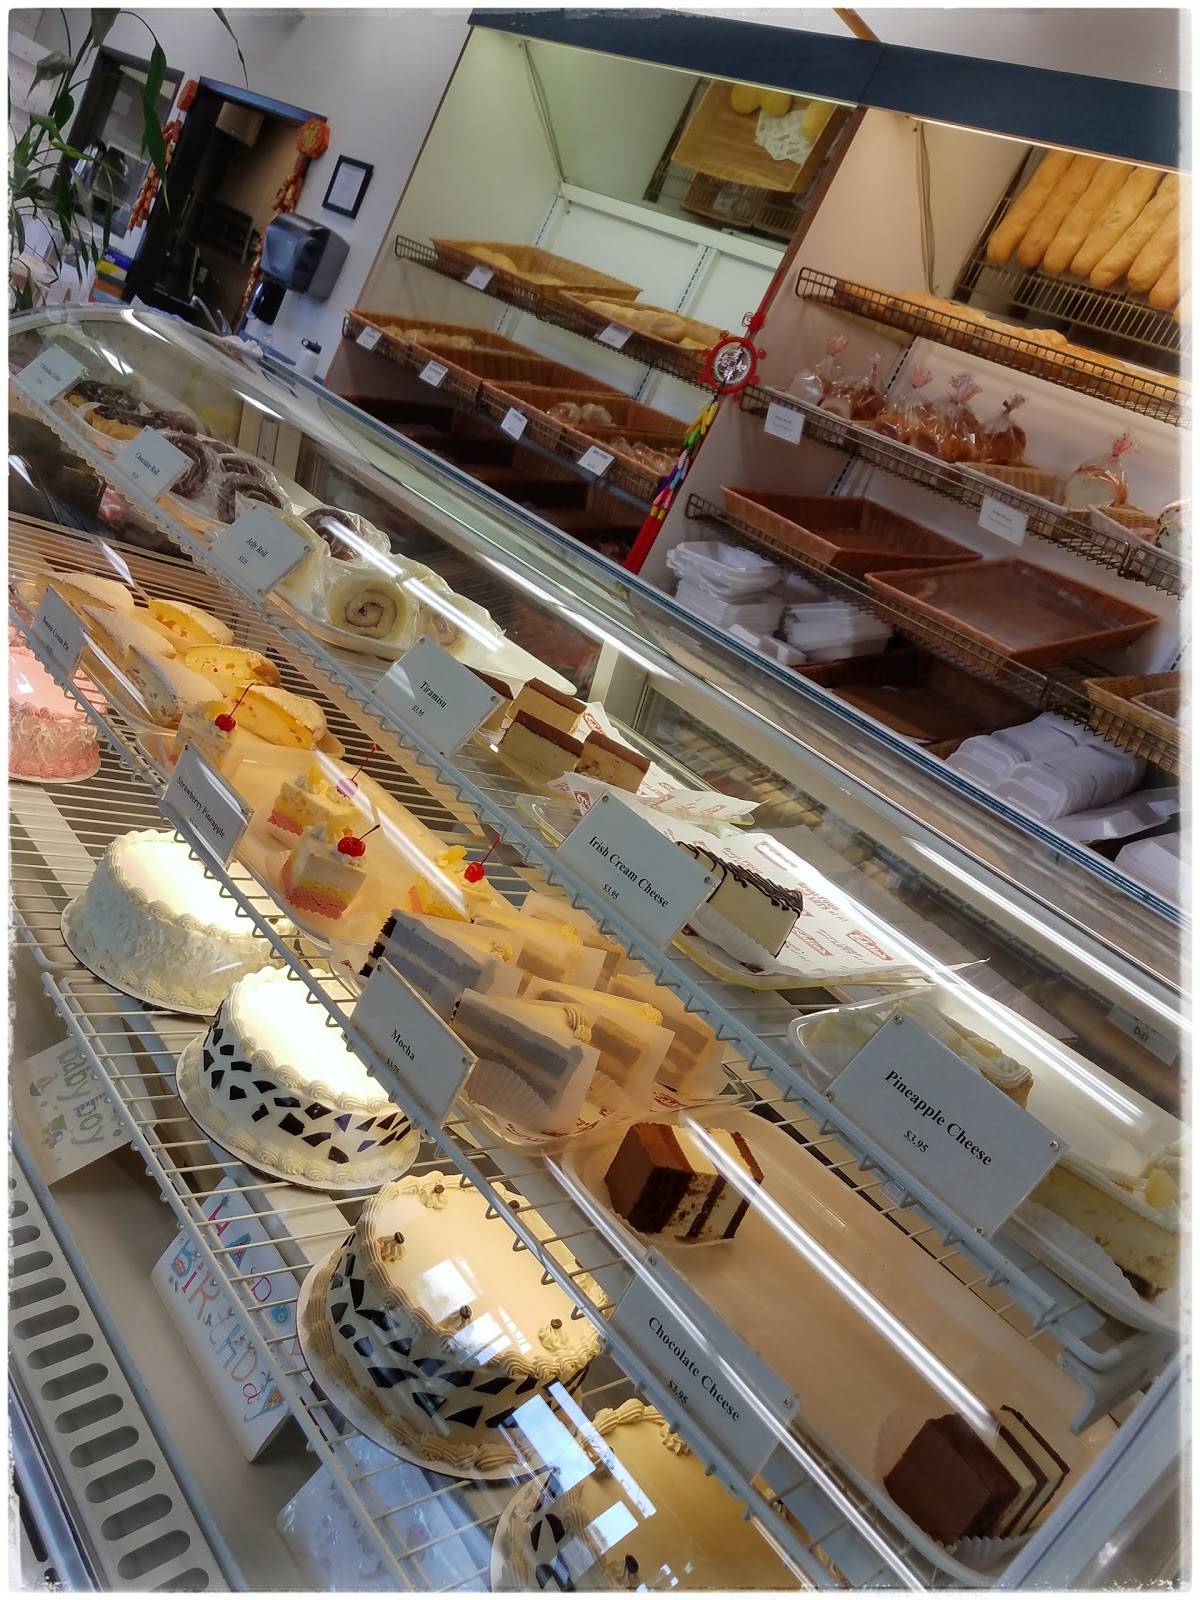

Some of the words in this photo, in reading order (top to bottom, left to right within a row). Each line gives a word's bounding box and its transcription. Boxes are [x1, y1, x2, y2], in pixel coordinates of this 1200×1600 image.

[245, 537, 258, 551] Jelly
[255, 545, 270, 558] Roll
[419, 680, 447, 708] Tiramisu
[176, 776, 202, 811] Strawberry
[202, 807, 225, 839] Pineapple
[588, 836, 609, 857] Irish
[609, 853, 638, 882] Cream
[638, 878, 669, 908] Cheese
[602, 883, 620, 900] $3.95
[391, 1029, 416, 1061] Mocha
[885, 1070, 945, 1126] Pineapple
[946, 1123, 993, 1166] Cheese
[903, 1130, 929, 1153] $3.95
[648, 1317, 700, 1377] Chocolate
[701, 1375, 740, 1422] Cheese
[668, 1380, 689, 1404] $3.95
